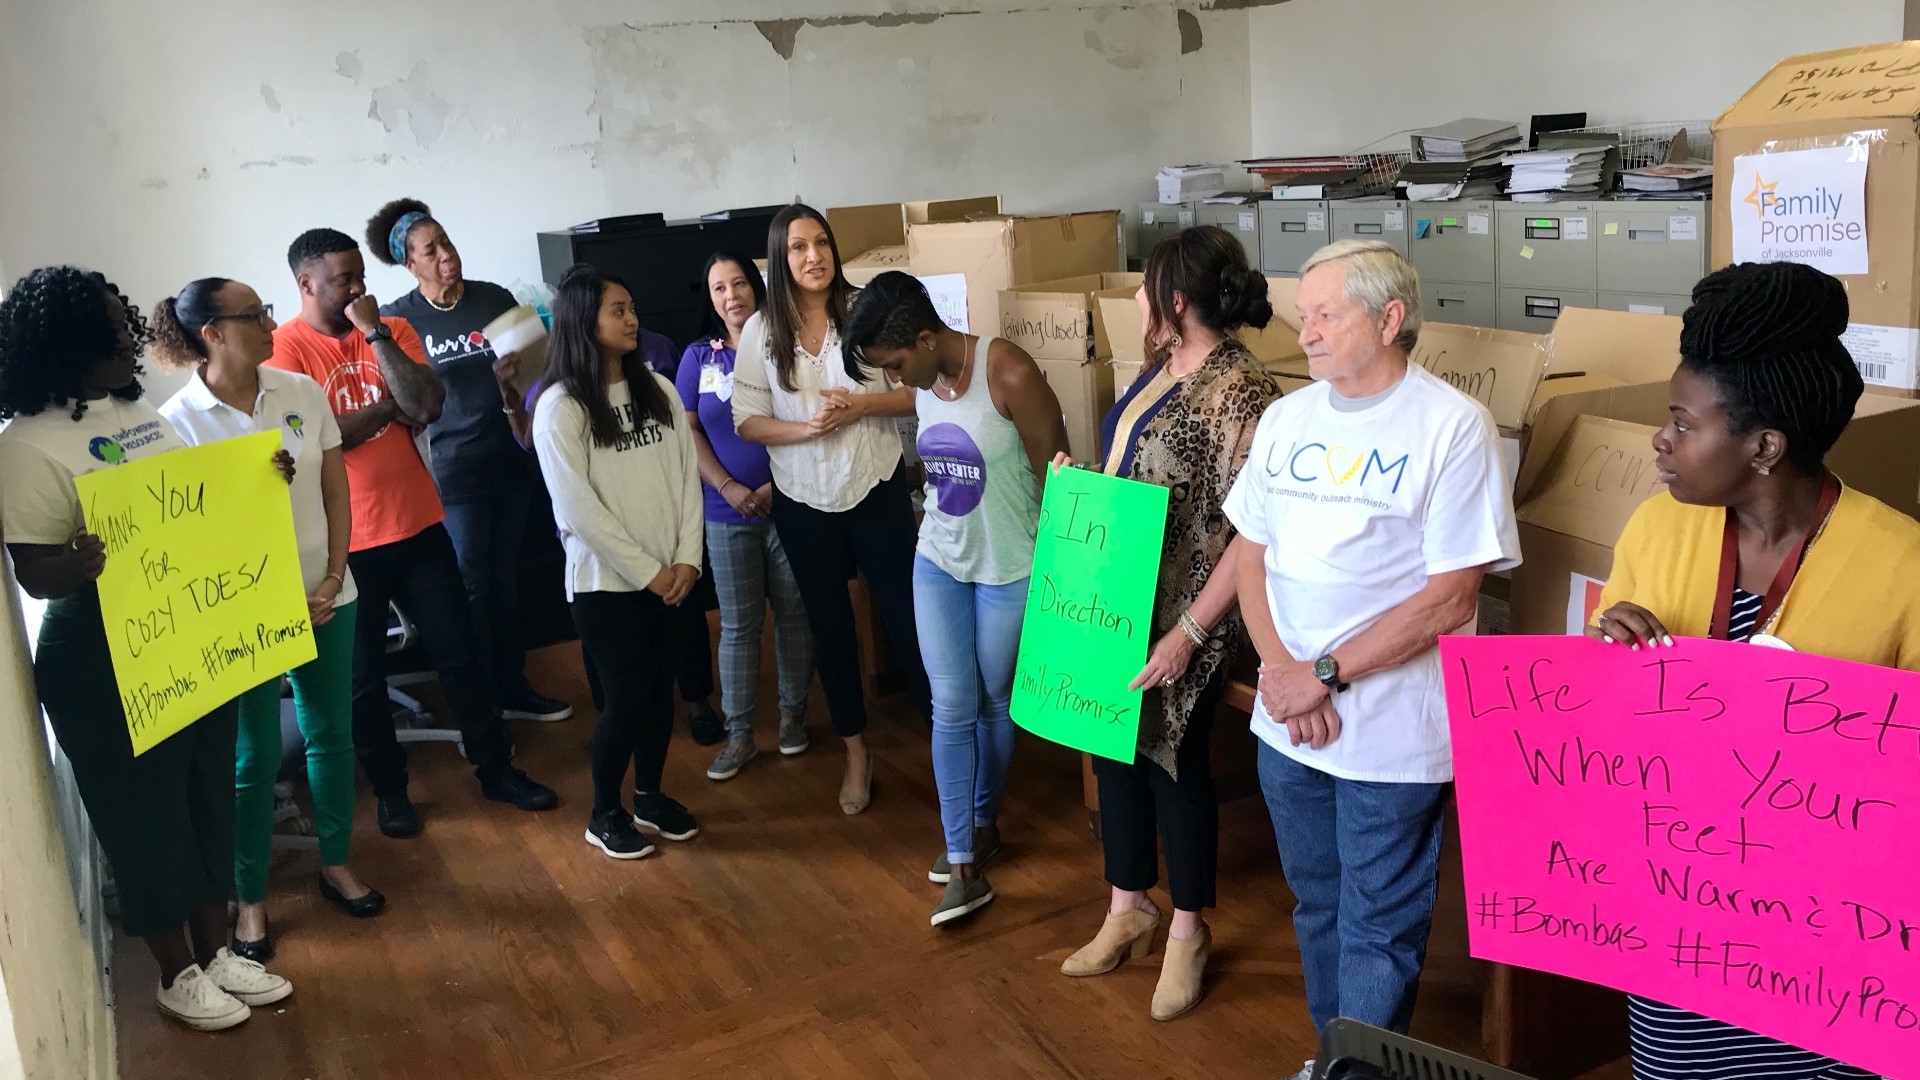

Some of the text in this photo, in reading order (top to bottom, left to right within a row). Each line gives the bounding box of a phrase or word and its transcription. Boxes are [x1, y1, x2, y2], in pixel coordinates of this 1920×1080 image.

[1761, 187, 1843, 220] Family
[1761, 216, 1861, 244] Promise
[1761, 247, 1833, 259] of Jacksonville
[1003, 312, 1085, 349] Giving Closet
[615, 424, 663, 452] OSPREYS
[146, 470, 205, 523] YOU
[946, 462, 981, 481] CENTER
[1055, 492, 1106, 550] In
[1275, 488, 1319, 502] community
[1320, 493, 1352, 503] outreach
[1353, 496, 1392, 511] ministry
[141, 548, 180, 590] FOR
[126, 554, 268, 658] COZY TOES!
[1040, 573, 1132, 639] Direction
[124, 665, 198, 737] #Bombas
[1460, 657, 1920, 755] Life Is Bet
[1514, 729, 1896, 830] When Your
[1642, 801, 1775, 864] Feet
[1547, 840, 1616, 885] Are
[1646, 859, 1791, 923] Warm
[1474, 891, 1920, 1031] #Bombas #FamilyPro
